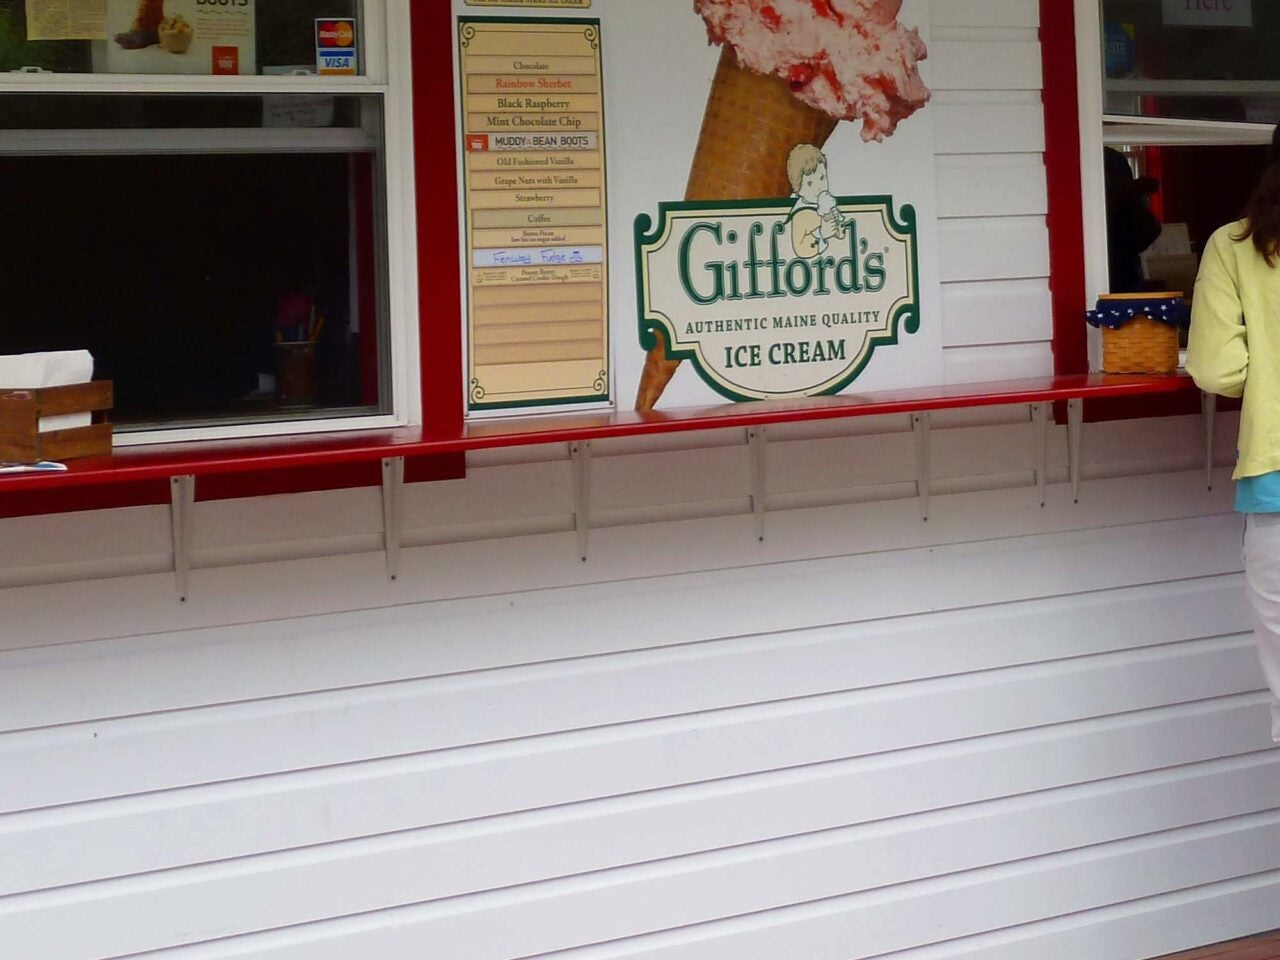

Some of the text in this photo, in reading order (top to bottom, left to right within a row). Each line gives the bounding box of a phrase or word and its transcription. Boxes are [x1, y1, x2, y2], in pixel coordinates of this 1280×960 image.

[325, 58, 349, 68] VISA
[513, 61, 549, 70] Chocolate
[495, 78, 572, 88] Rainbow Sherbet
[497, 98, 570, 110] Black Raspberry
[487, 116, 581, 129] Mint Chocolate Chip
[495, 137, 525, 146] MUDDY
[533, 137, 557, 146] BEAN
[560, 136, 589, 146] BOOTS
[496, 157, 574, 166] Old Fashioned Vanilla
[495, 176, 578, 187] Grape Nuts with Vanilla
[515, 193, 554, 204] Strawberry
[527, 214, 551, 224] Coffee
[493, 248, 566, 265] Fenway Fudge
[678, 218, 887, 305] Gifford's
[685, 310, 881, 334] AUTHENTIC MAINE QUALITY
[725, 339, 846, 368] ICE CREAM
